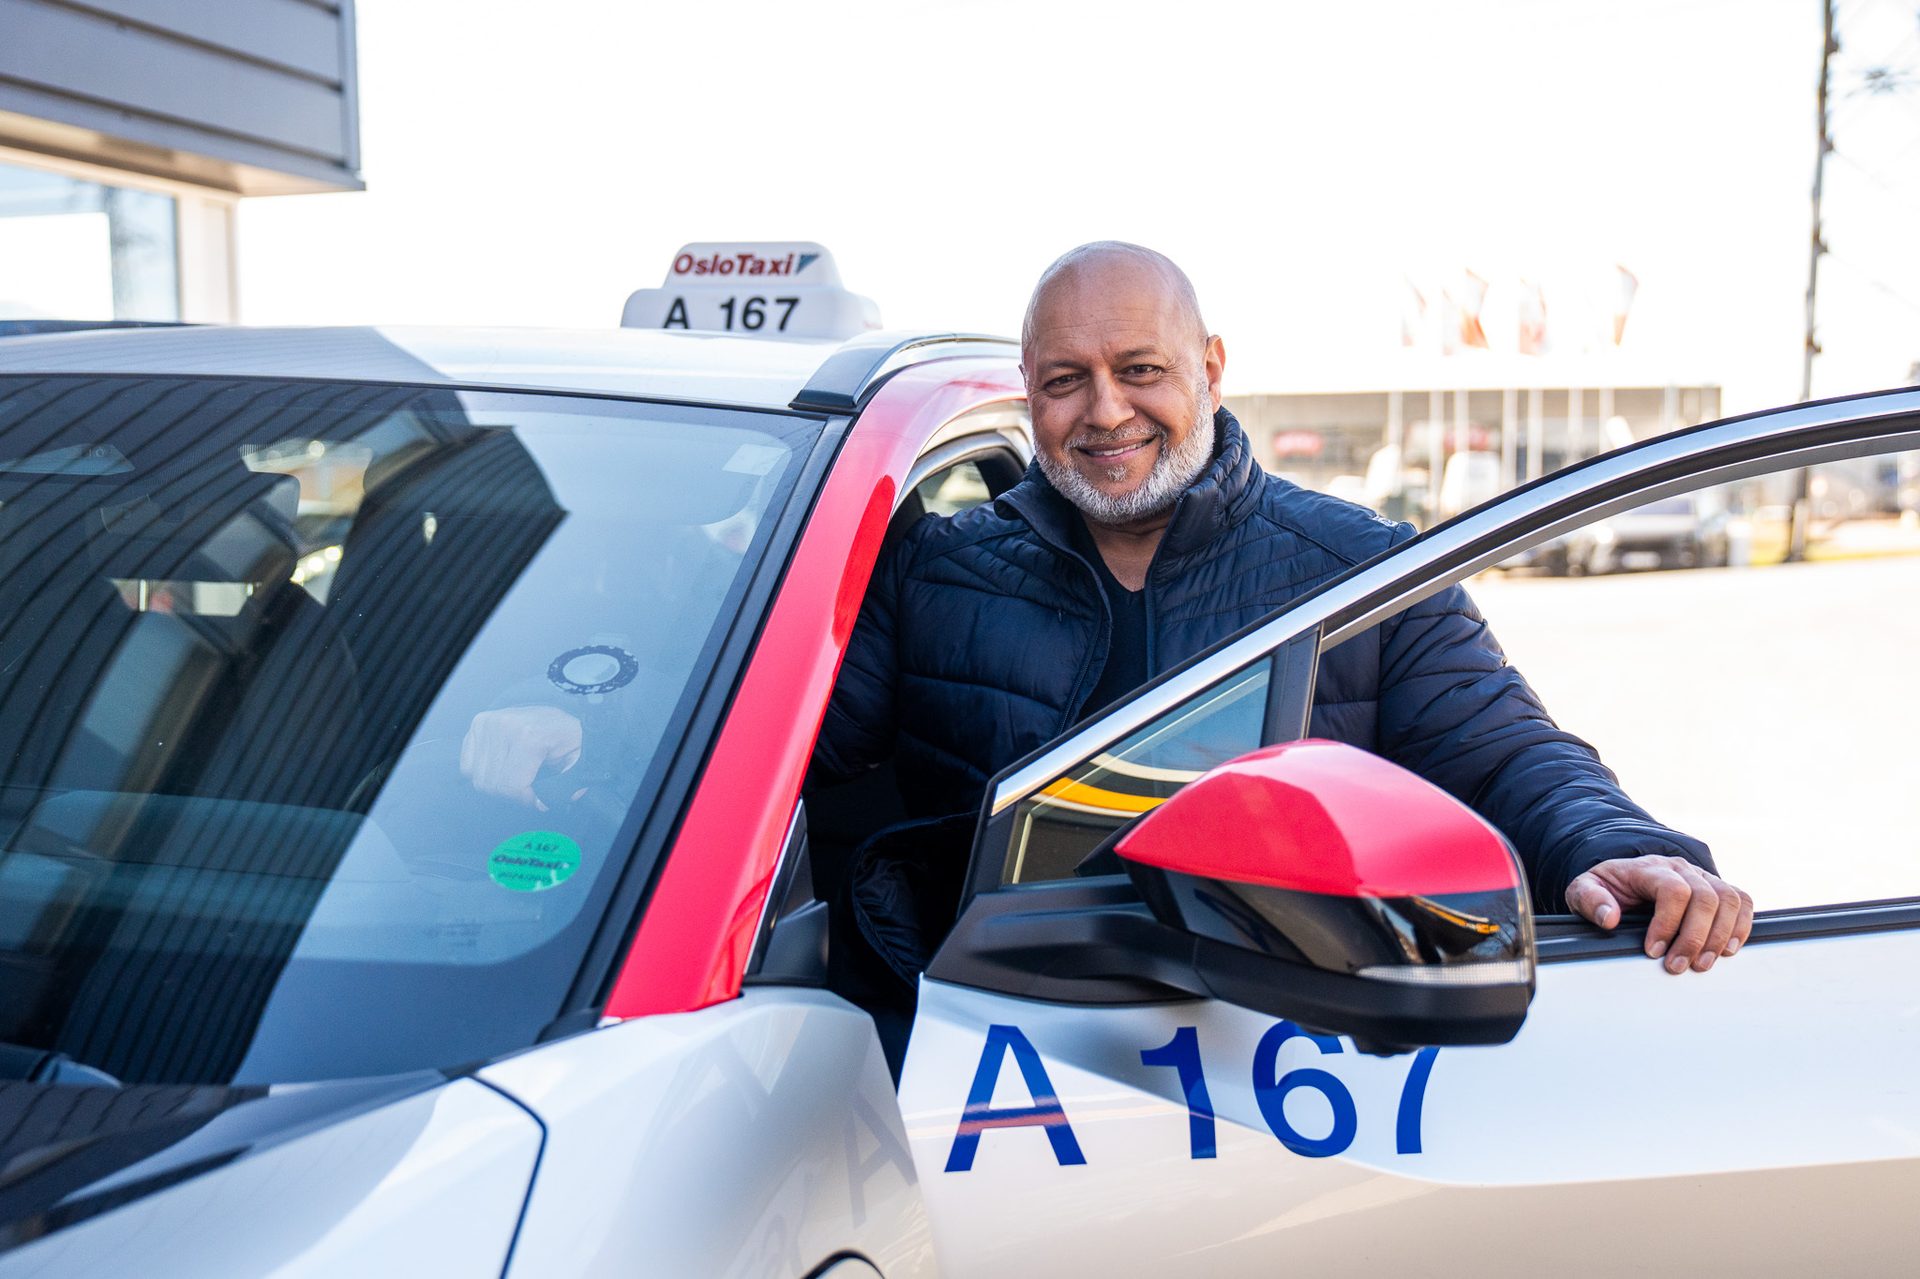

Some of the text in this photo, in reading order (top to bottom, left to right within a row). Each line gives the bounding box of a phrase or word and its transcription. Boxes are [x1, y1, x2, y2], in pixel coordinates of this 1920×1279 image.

[674, 253, 795, 276] OsloTaxi
[663, 296, 801, 331] A 167
[944, 1024, 1087, 1173] A
